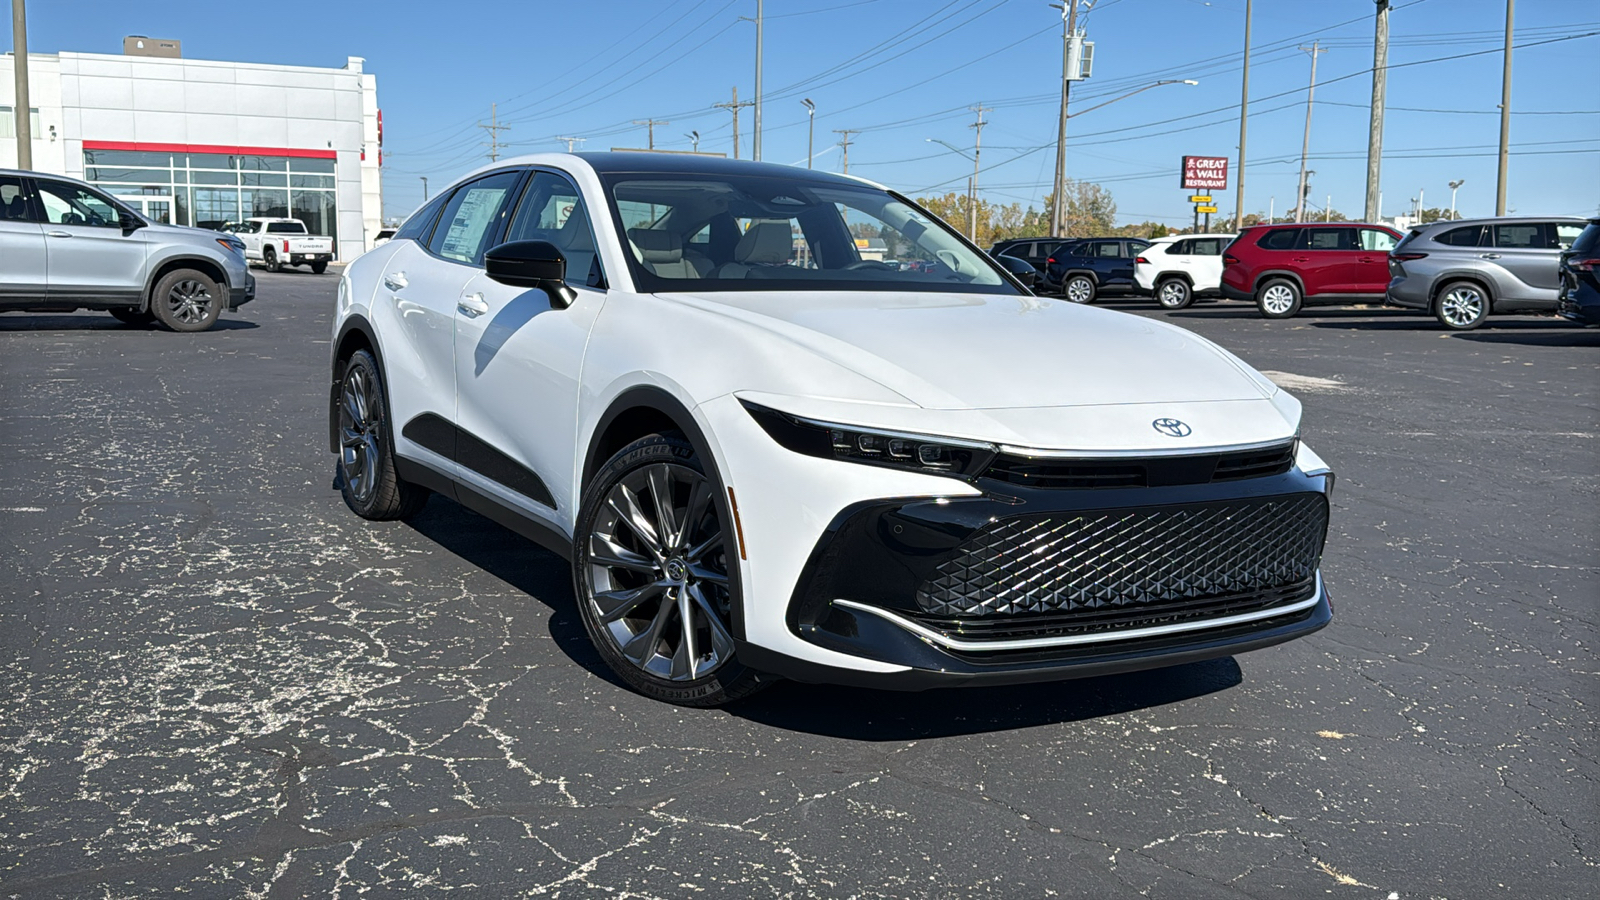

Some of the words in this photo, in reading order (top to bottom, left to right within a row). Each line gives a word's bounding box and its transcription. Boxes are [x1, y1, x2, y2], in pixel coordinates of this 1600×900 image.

[1196, 160, 1226, 168] GREAT
[1196, 170, 1224, 178] WALL
[1185, 179, 1226, 187] RESTAURANT
[630, 445, 690, 460] MICHELIN
[645, 684, 707, 700] MICHELIN
